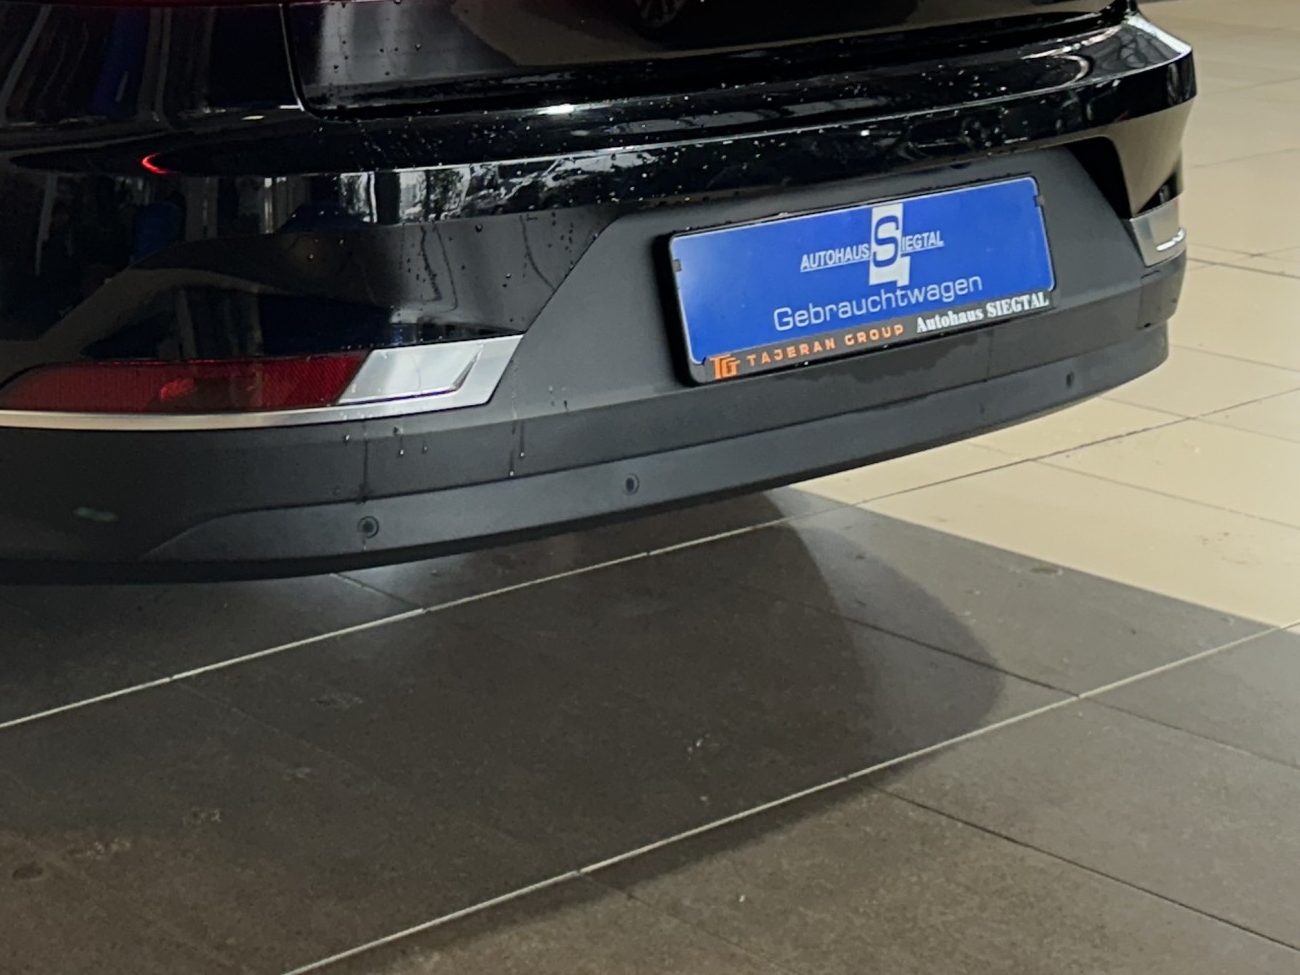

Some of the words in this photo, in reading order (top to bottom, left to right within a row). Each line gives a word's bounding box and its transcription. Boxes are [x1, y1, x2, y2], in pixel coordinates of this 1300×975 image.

[800, 243, 870, 270] AUTOHAUS
[773, 275, 983, 332] Gebrauchtwagen
[916, 307, 984, 334] Autohaus
[985, 291, 1050, 319] SIEGTAL
[746, 338, 836, 366] TAJERAN
[844, 324, 905, 347] GROUP
